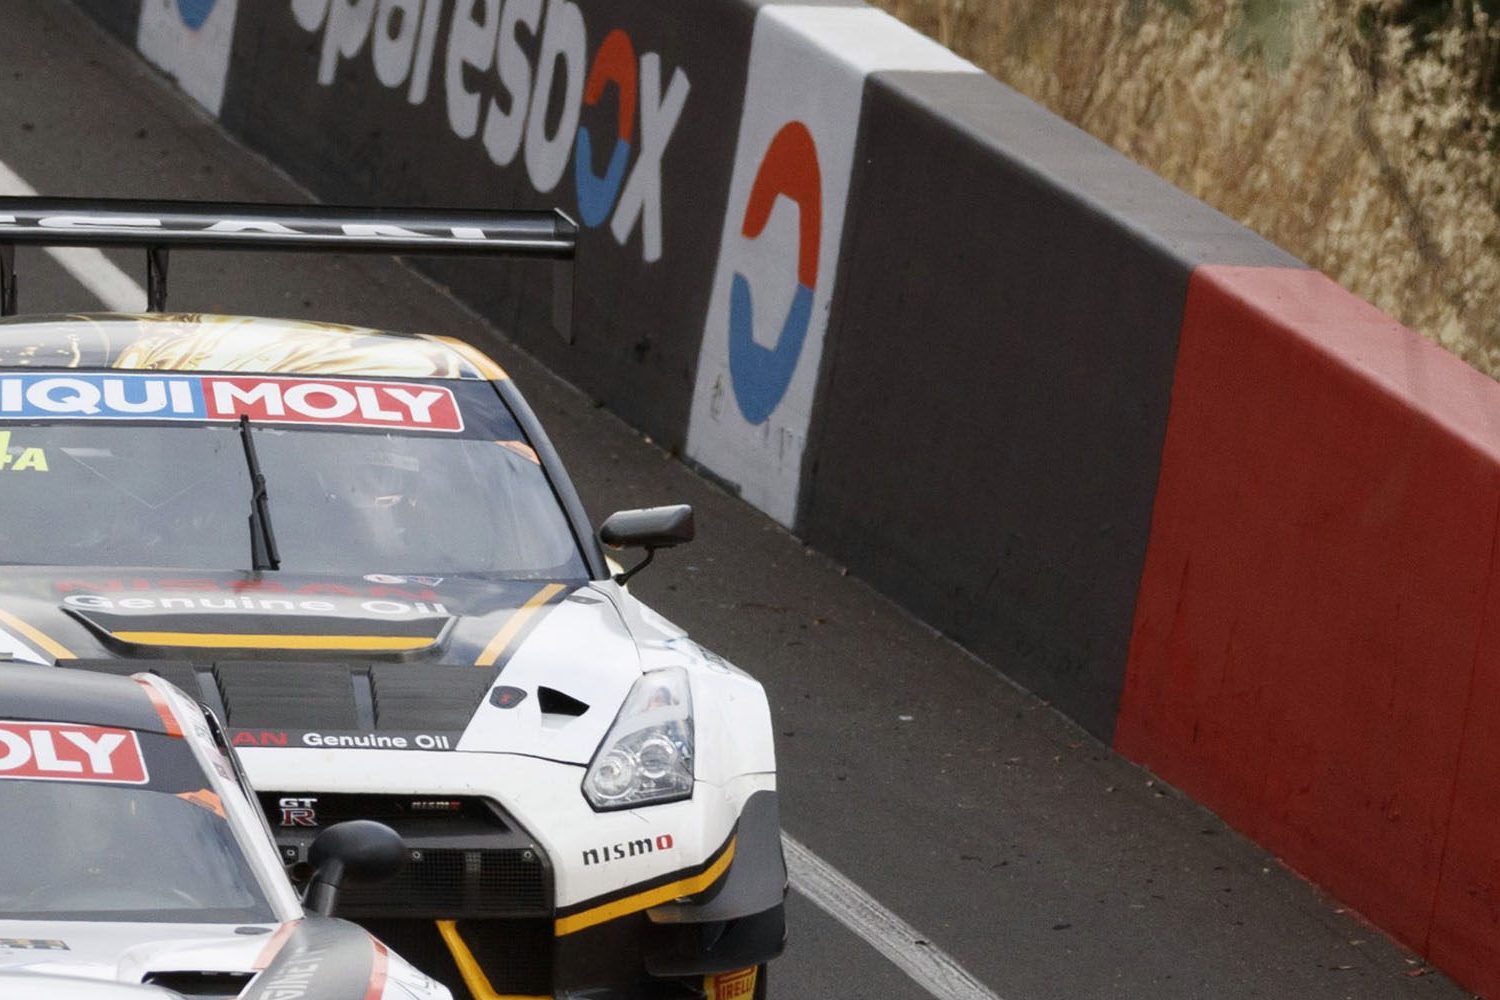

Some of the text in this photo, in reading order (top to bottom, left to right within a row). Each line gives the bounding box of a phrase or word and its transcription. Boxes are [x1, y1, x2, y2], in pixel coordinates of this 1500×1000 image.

[211, 380, 444, 424] MOLY
[64, 594, 448, 615] Genuine Oil
[302, 732, 408, 749] Genuine
[415, 734, 450, 750] Oil
[581, 833, 674, 867] nismo
